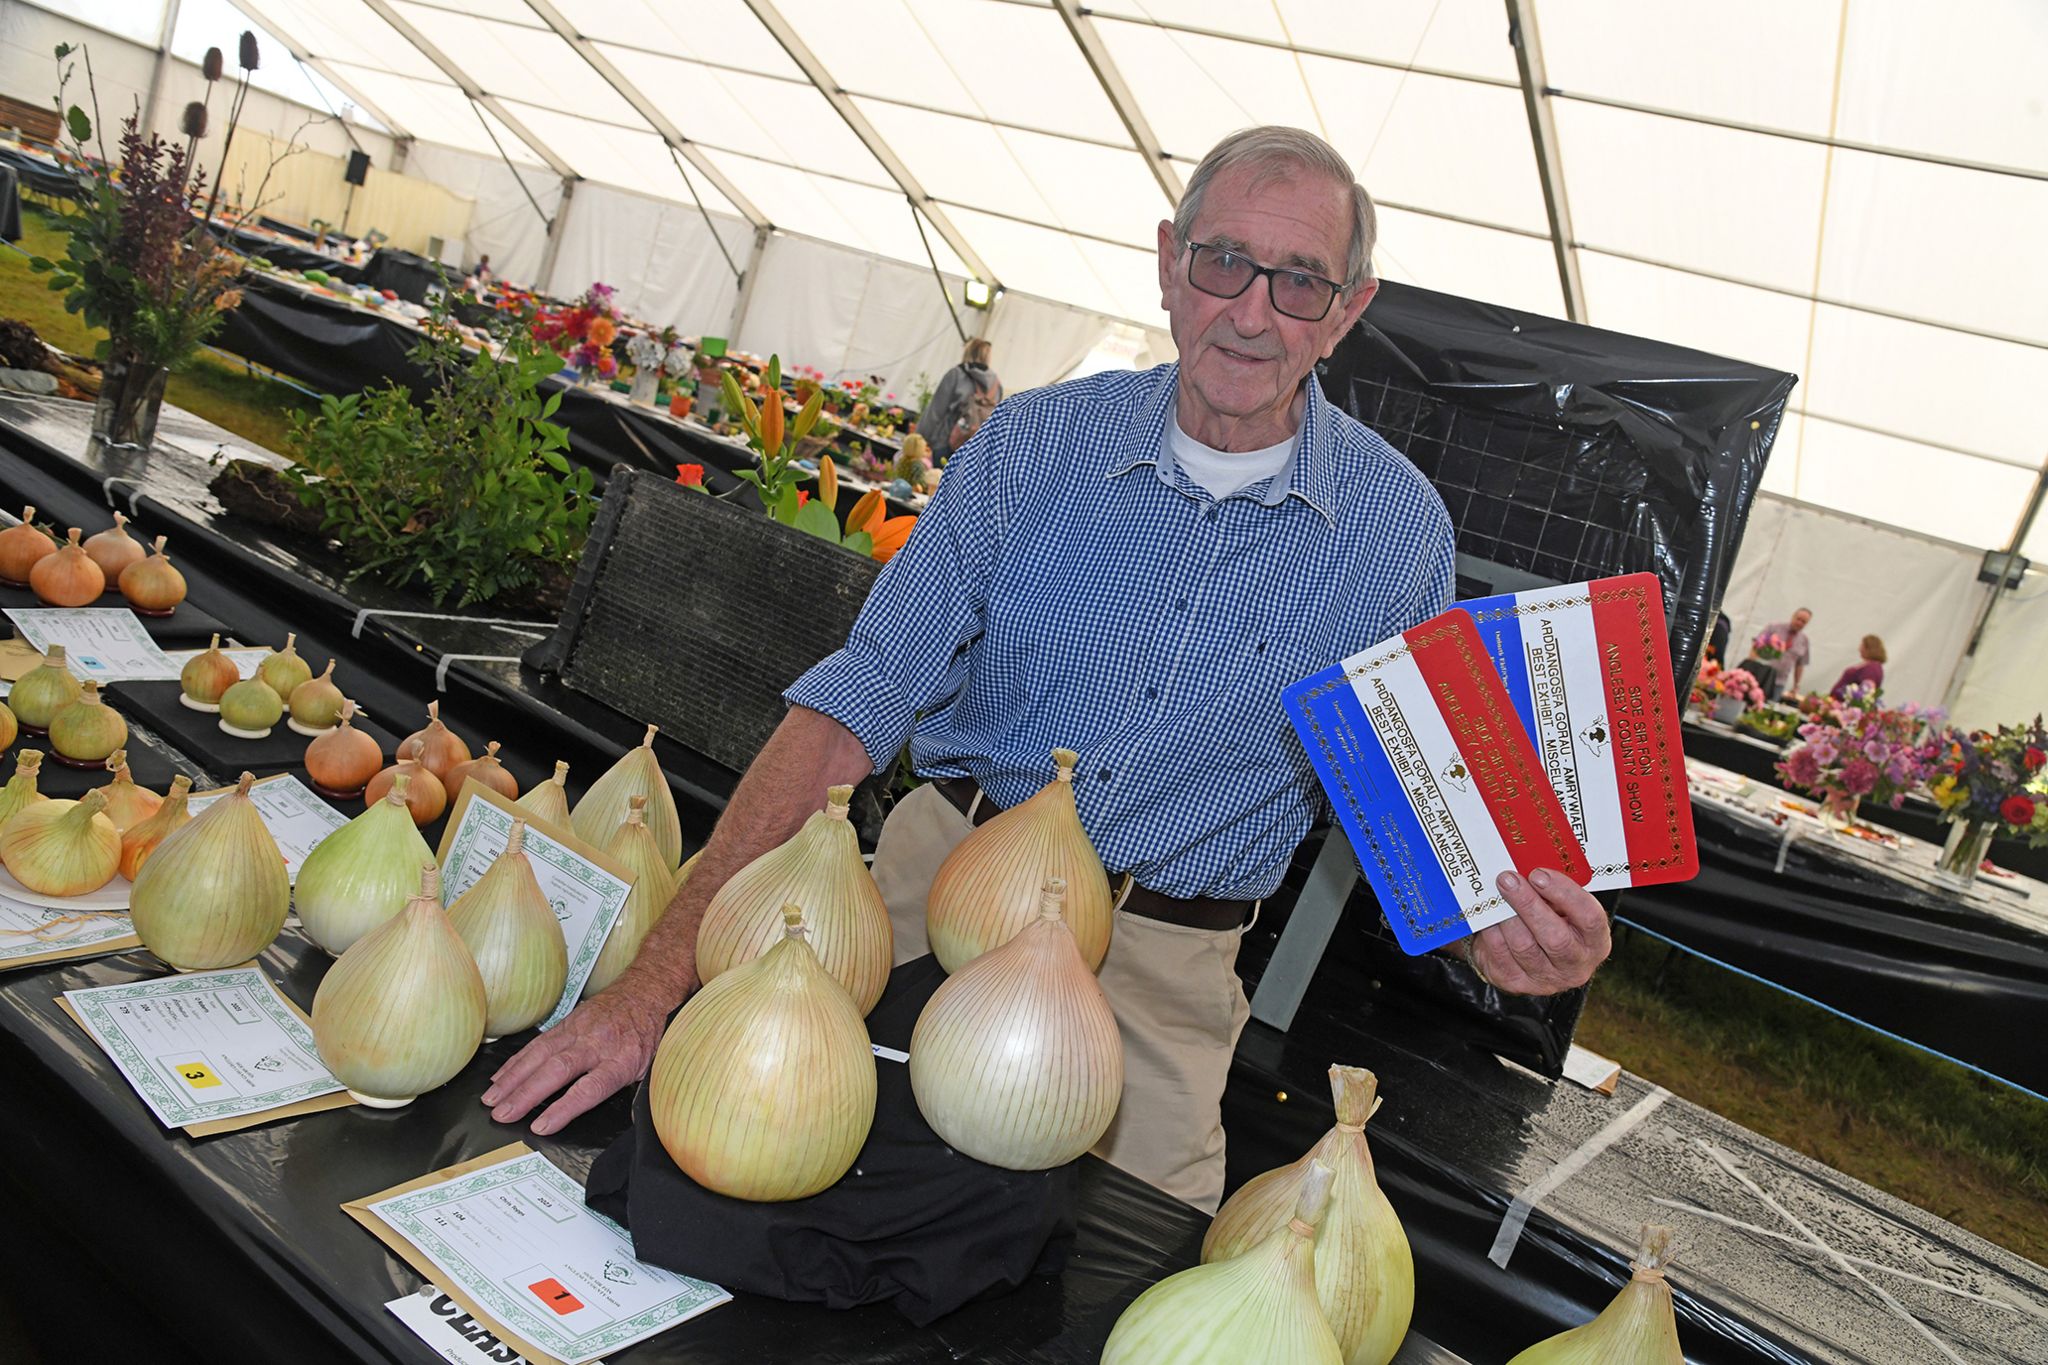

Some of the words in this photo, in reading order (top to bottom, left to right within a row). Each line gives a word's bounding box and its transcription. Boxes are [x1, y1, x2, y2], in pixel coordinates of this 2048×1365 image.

[1532, 648, 1546, 678] BEST
[1541, 620, 1563, 708] ARDDANGOSFA
[1555, 712, 1571, 755] GORAU
[1605, 640, 1627, 713] ANGLESEY
[1537, 683, 1554, 727] EXHIBIT
[1627, 685, 1644, 717] SIOE
[1471, 714, 1495, 747] SIOE
[1487, 747, 1506, 770] SIR
[1616, 718, 1637, 777] COUNTY
[1633, 721, 1648, 744] SIR
[1372, 679, 1420, 758] ARDDANGOSFA
[1413, 760, 1438, 799] GORAU
[1436, 806, 1483, 896] AMRYWIAETHOL
[1437, 679, 1478, 749] ANGLESEY
[1471, 748, 1506, 806] COUNTY
[1498, 805, 1526, 847] SHOW
[1372, 706, 1393, 733] BEST
[1387, 736, 1414, 777] EXHIBIT
[1412, 787, 1462, 877] MISCELLANEOUS
[1626, 781, 1644, 823] SHOW
[185, 1071, 205, 1080] 3
[554, 1291, 570, 1300] 1
